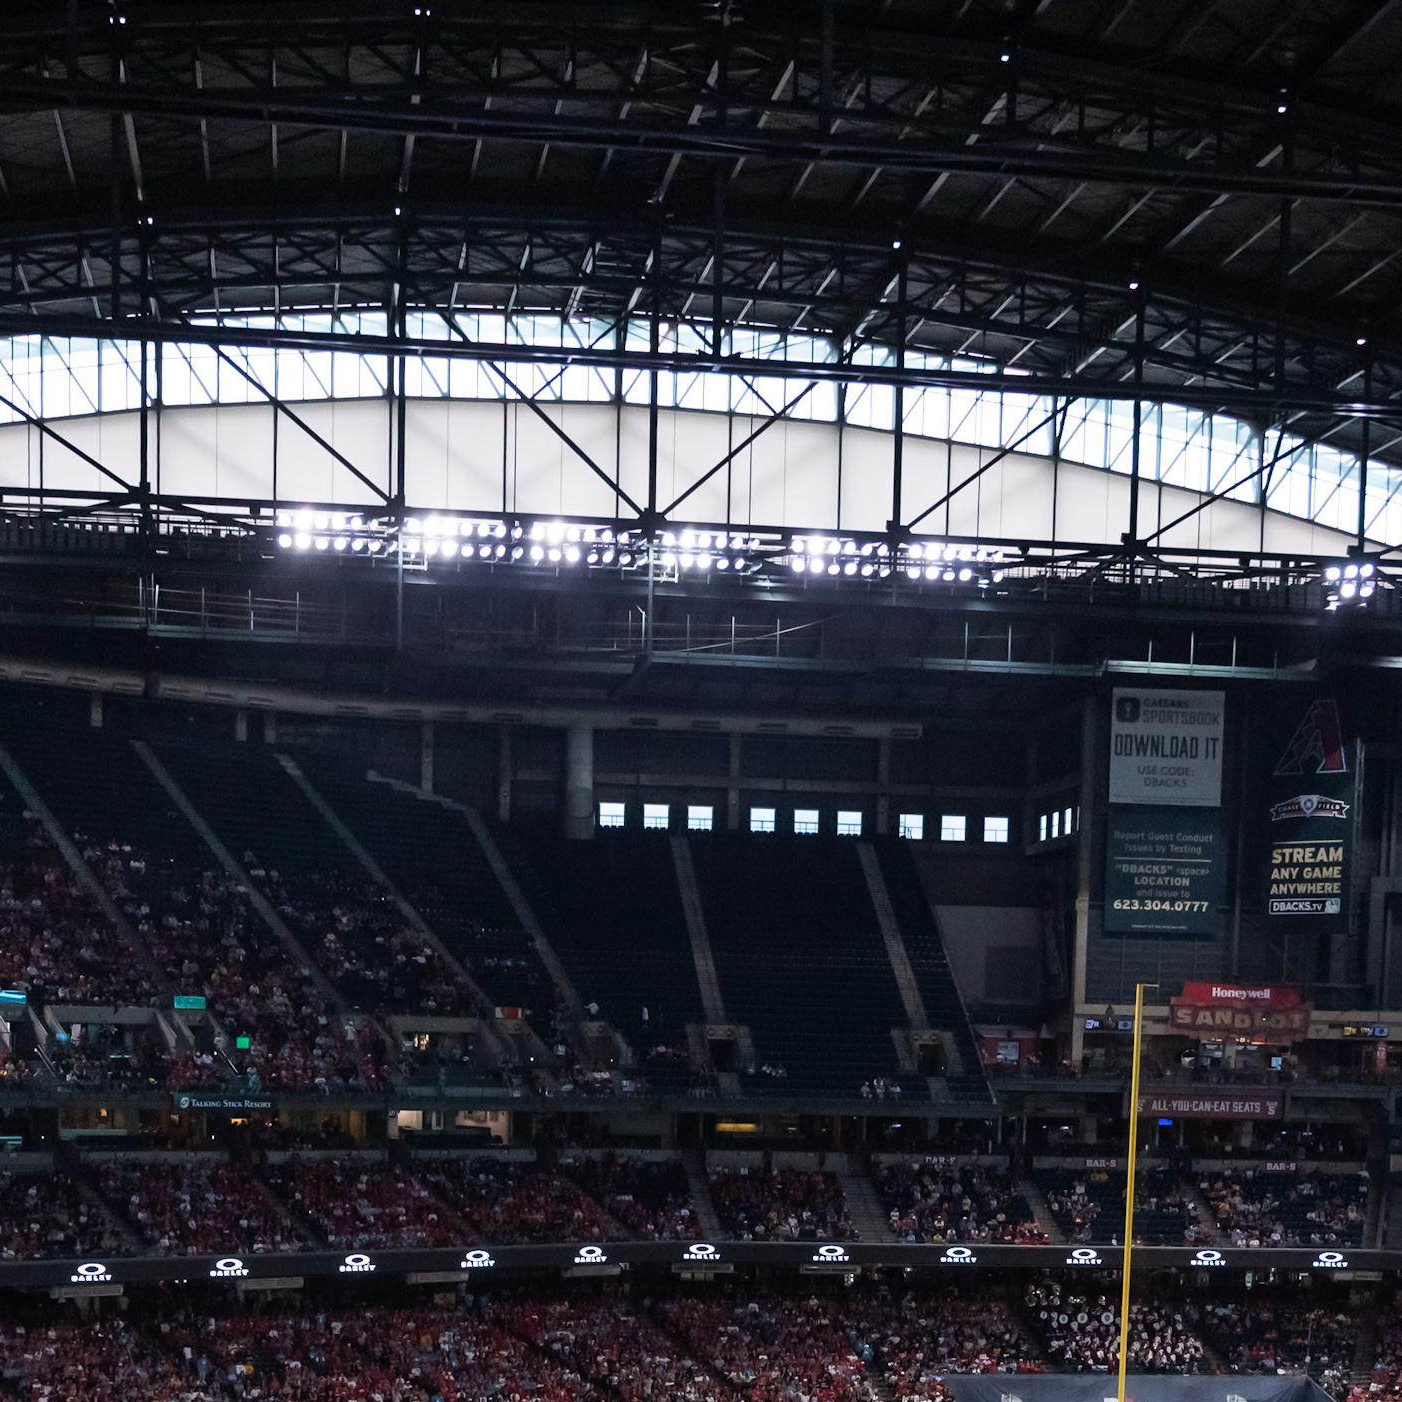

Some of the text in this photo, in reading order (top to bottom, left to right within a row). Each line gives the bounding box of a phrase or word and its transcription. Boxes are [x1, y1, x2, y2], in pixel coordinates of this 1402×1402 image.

[1141, 710, 1221, 725] SPORTSBOOK
[1113, 733, 1220, 760] DOWNLOAD IT
[1137, 764, 1196, 777] USE CODE:
[1144, 777, 1188, 788] DBACKS
[1114, 831, 1214, 843] Report Guest Conduct
[1155, 844, 1203, 856] by Texting
[1271, 847, 1343, 864] STREAM
[1271, 867, 1342, 880] ANY GAME
[1134, 877, 1191, 887] LOCATION
[1137, 888, 1154, 897] and
[1270, 882, 1341, 895] ANYWHERE
[1112, 899, 1210, 912] 623.304.0777
[1211, 987, 1271, 1000] Honeywell
[190, 1099, 272, 1109] TALKING STICK RESORT
[1231, 1100, 1261, 1113] SEATS
[1086, 1158, 1117, 1168] BAR-S
[1266, 1161, 1296, 1171] BAR-S
[71, 1274, 112, 1283] OAKLEY
[209, 1268, 249, 1277] OAKLEY
